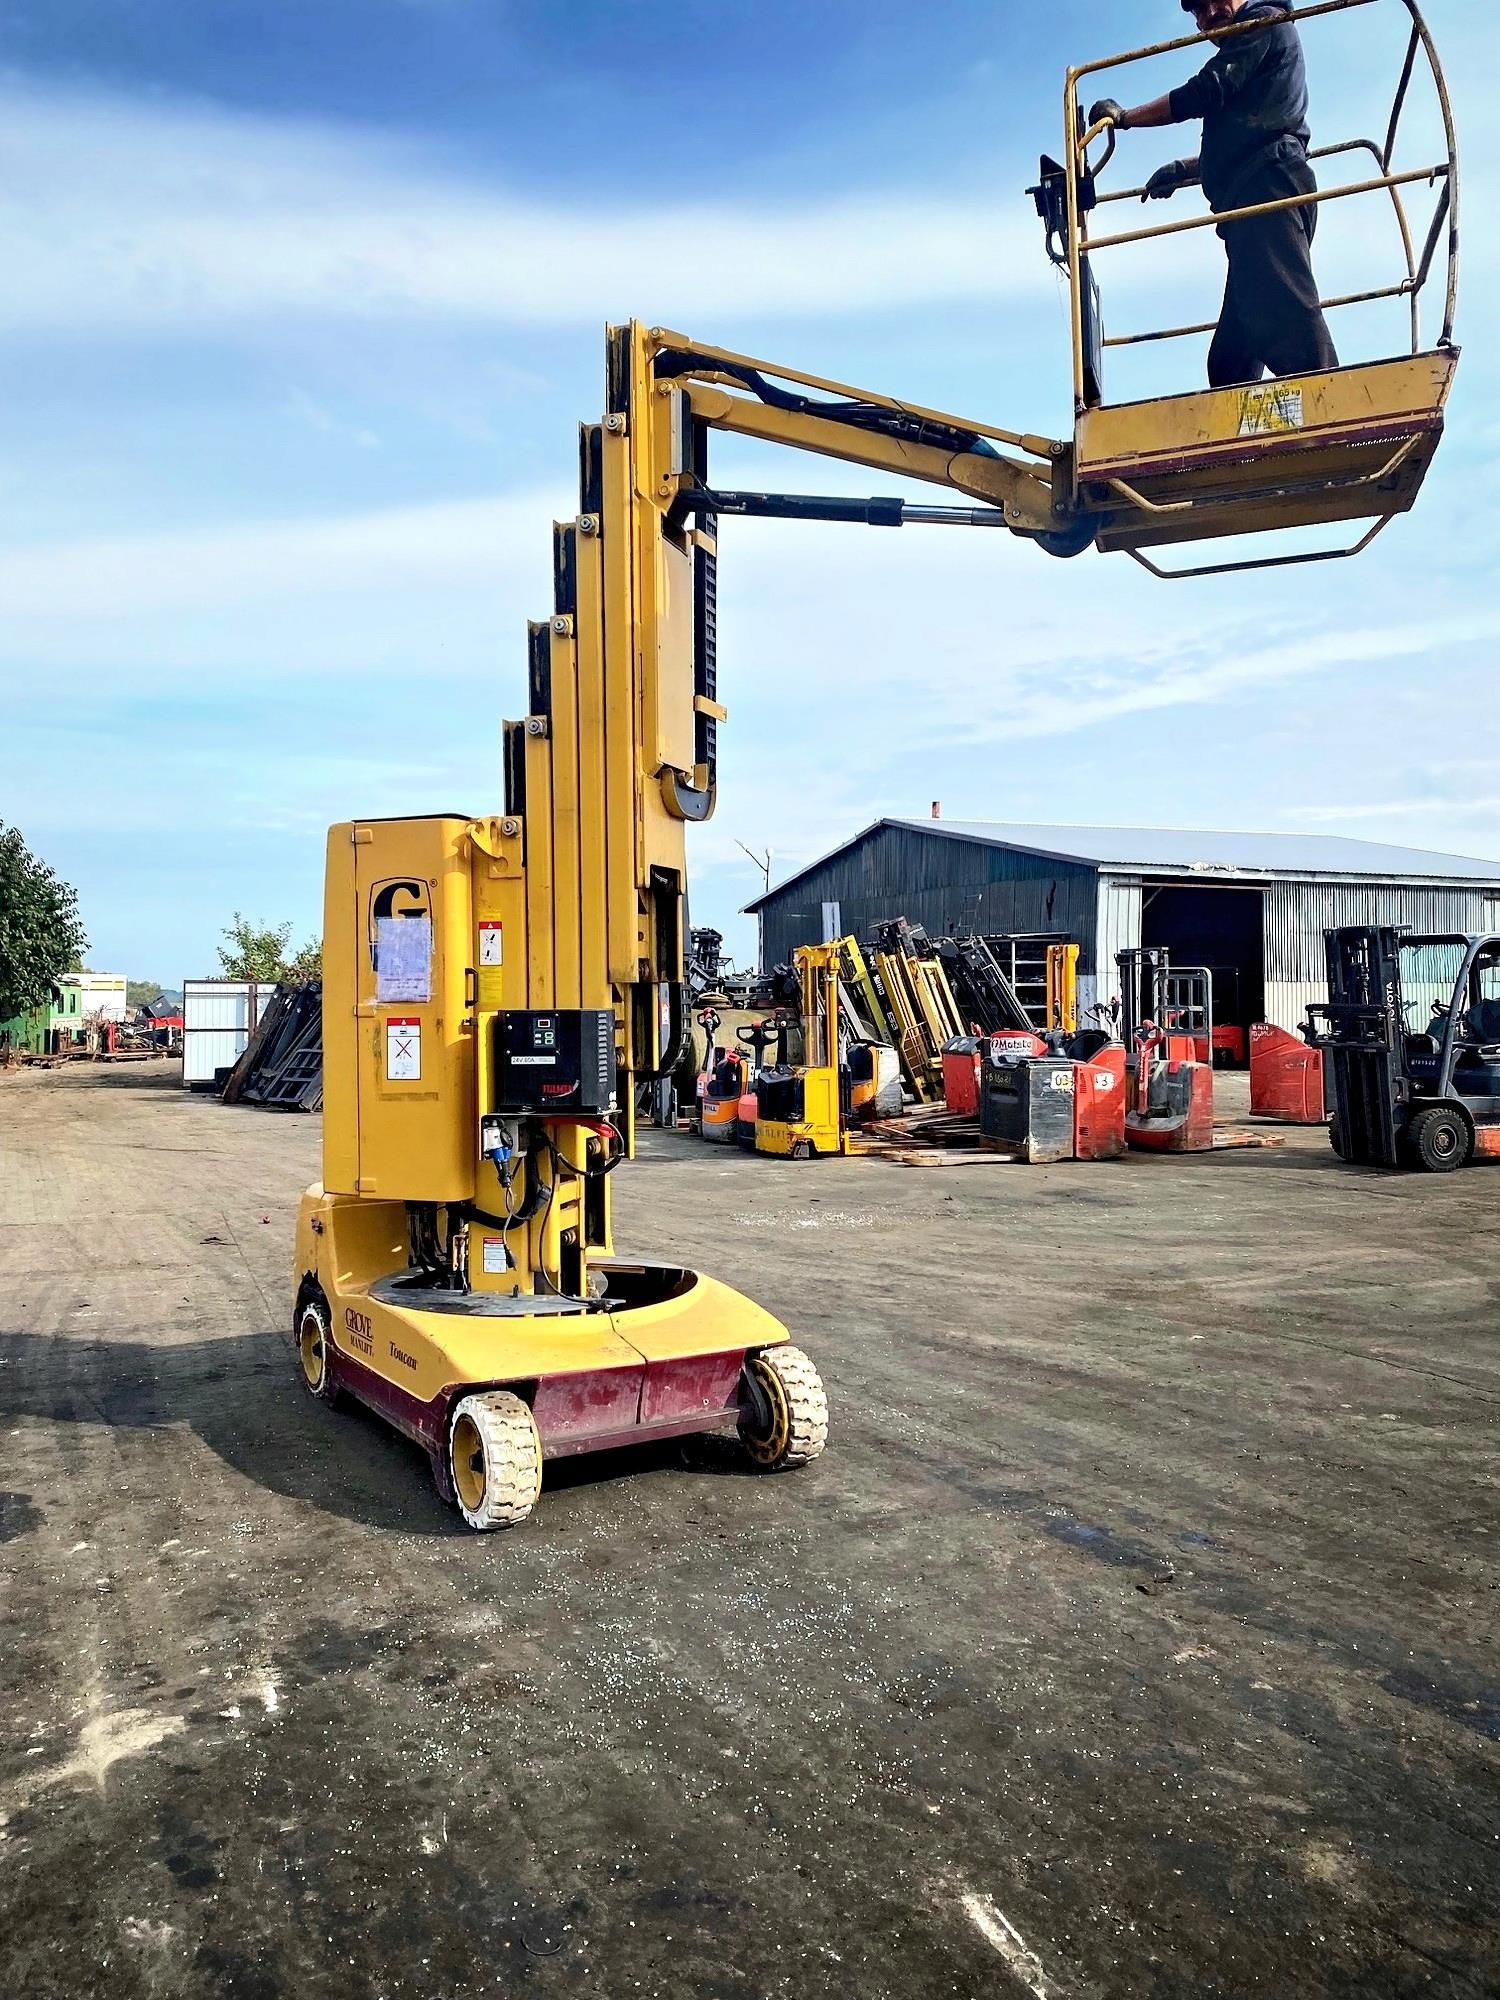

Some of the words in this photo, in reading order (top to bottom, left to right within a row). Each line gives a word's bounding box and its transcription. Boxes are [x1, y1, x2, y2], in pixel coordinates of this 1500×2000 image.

[873, 974, 885, 996] CLARK
[1385, 981, 1396, 1022] OYOTA
[345, 1306, 374, 1340] GROVE
[388, 1340, 418, 1371] Toucan
